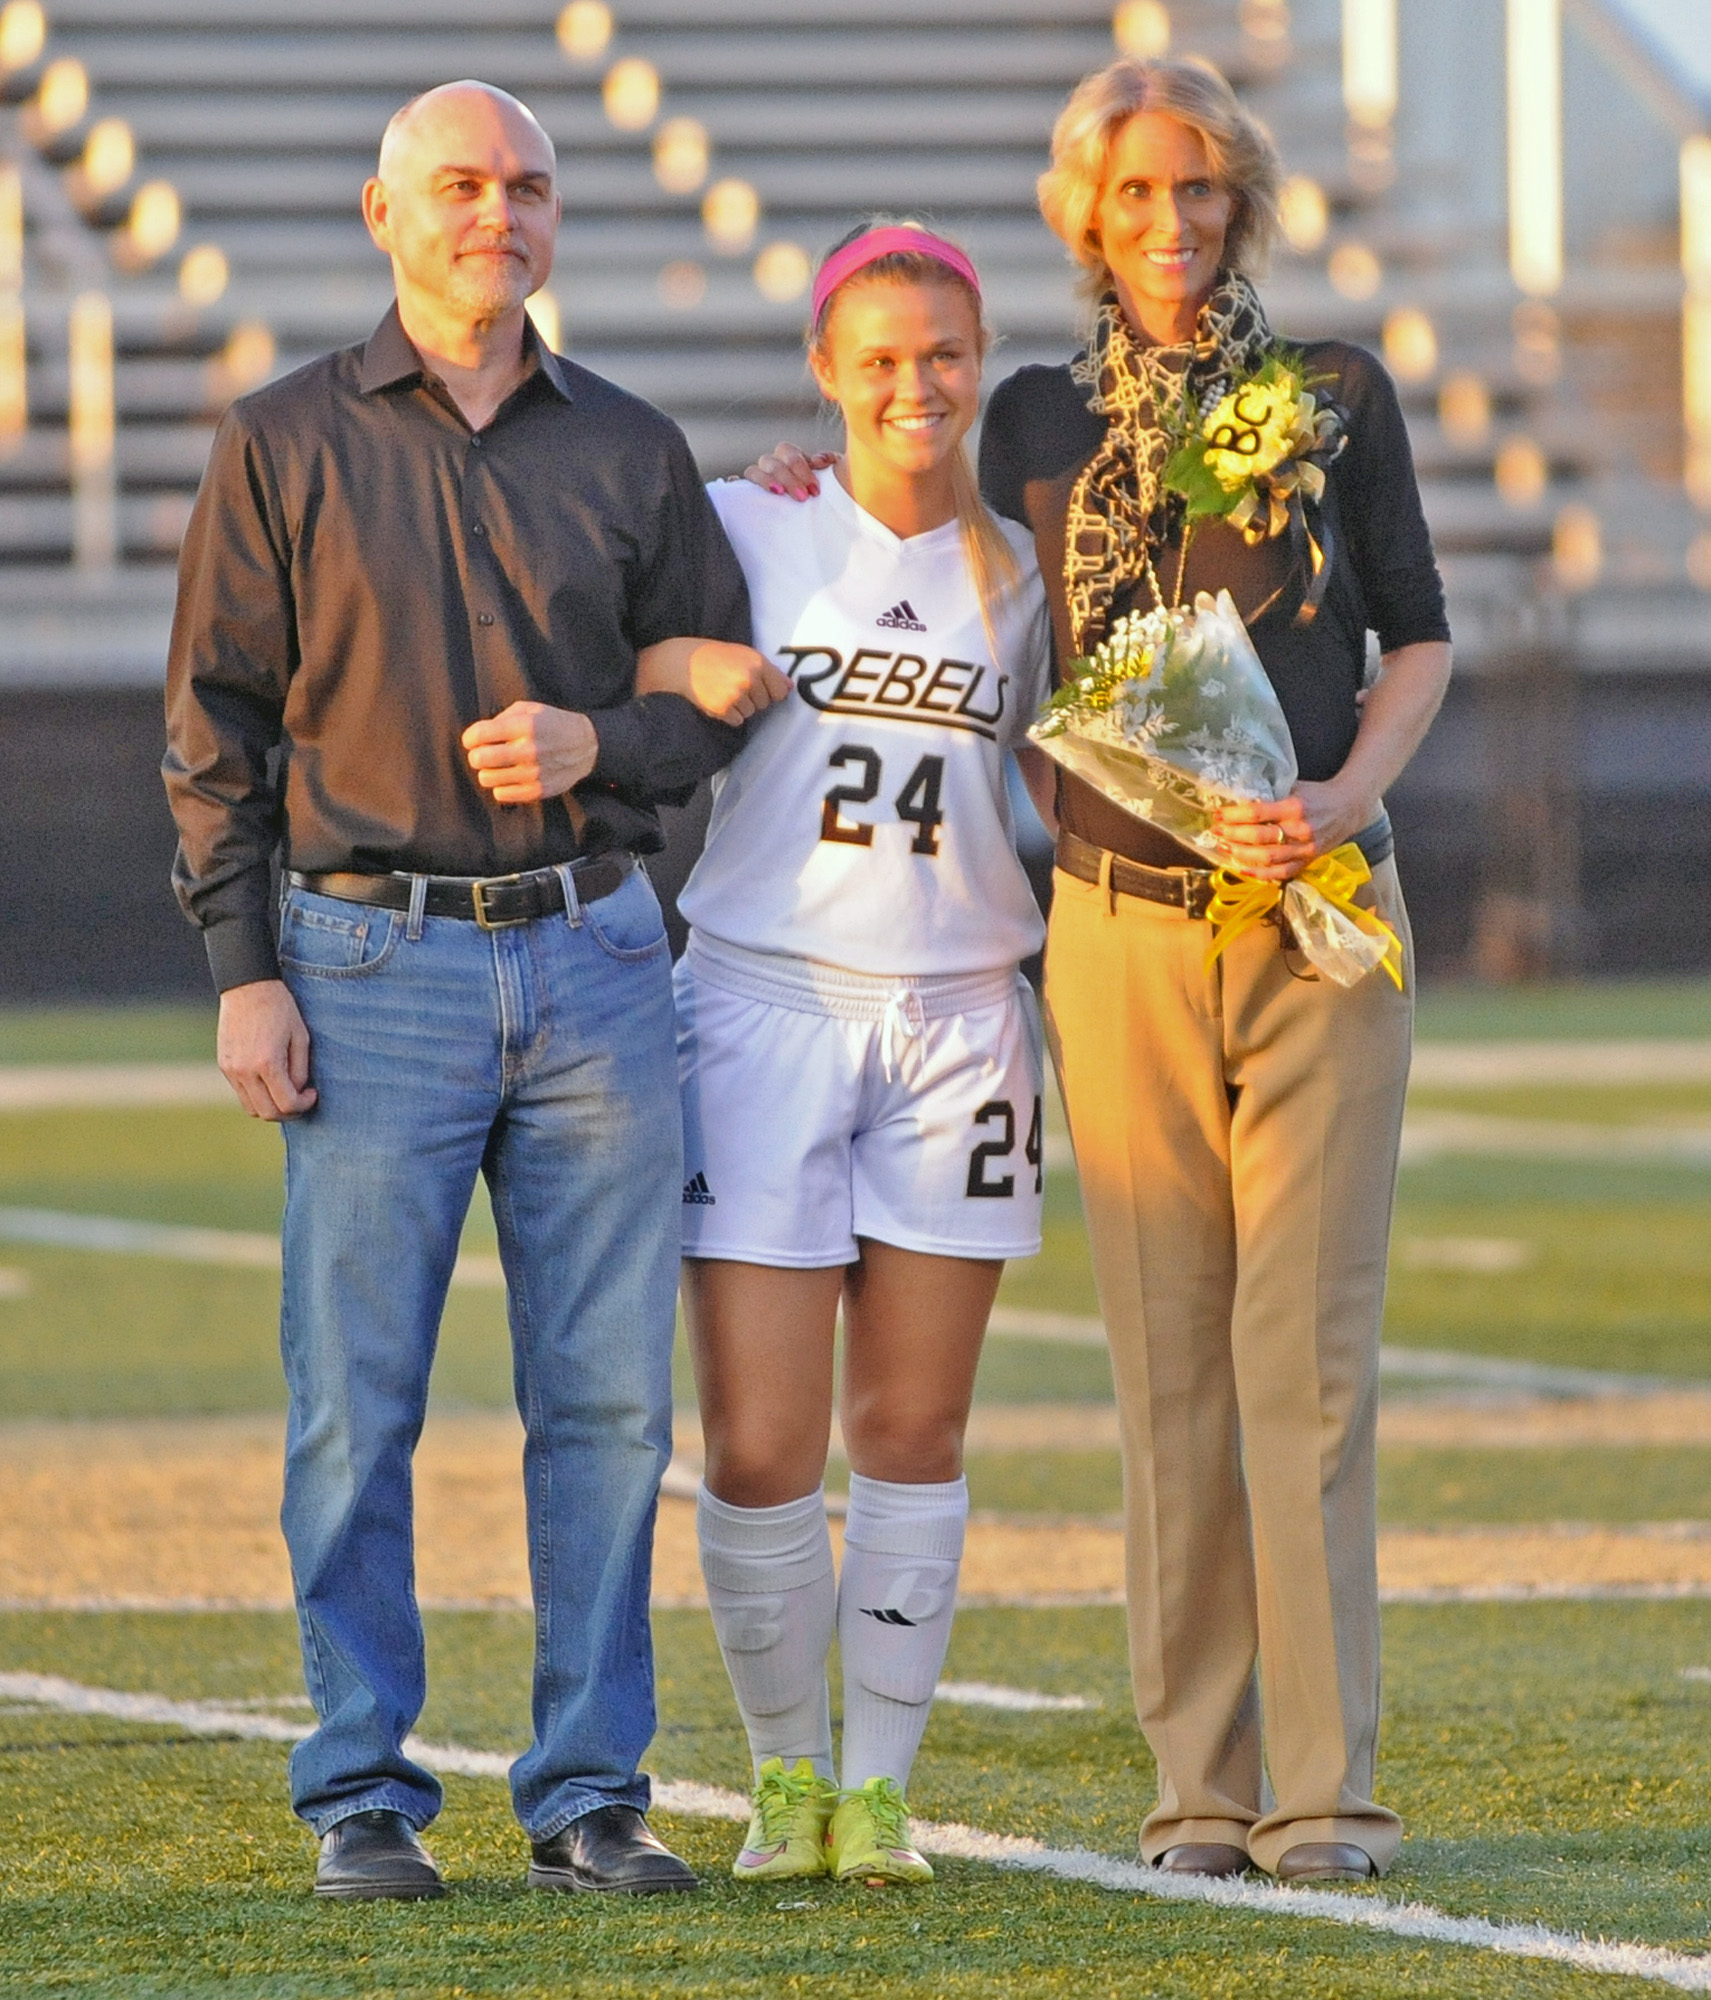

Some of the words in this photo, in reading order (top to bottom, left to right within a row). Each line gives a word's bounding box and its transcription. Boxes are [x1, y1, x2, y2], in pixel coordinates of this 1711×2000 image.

[1208, 392, 1272, 455] BC
[876, 616, 927, 632] adidas
[776, 645, 1010, 728] REBELS
[820, 744, 945, 856] 24
[966, 1095, 1042, 1197] 24
